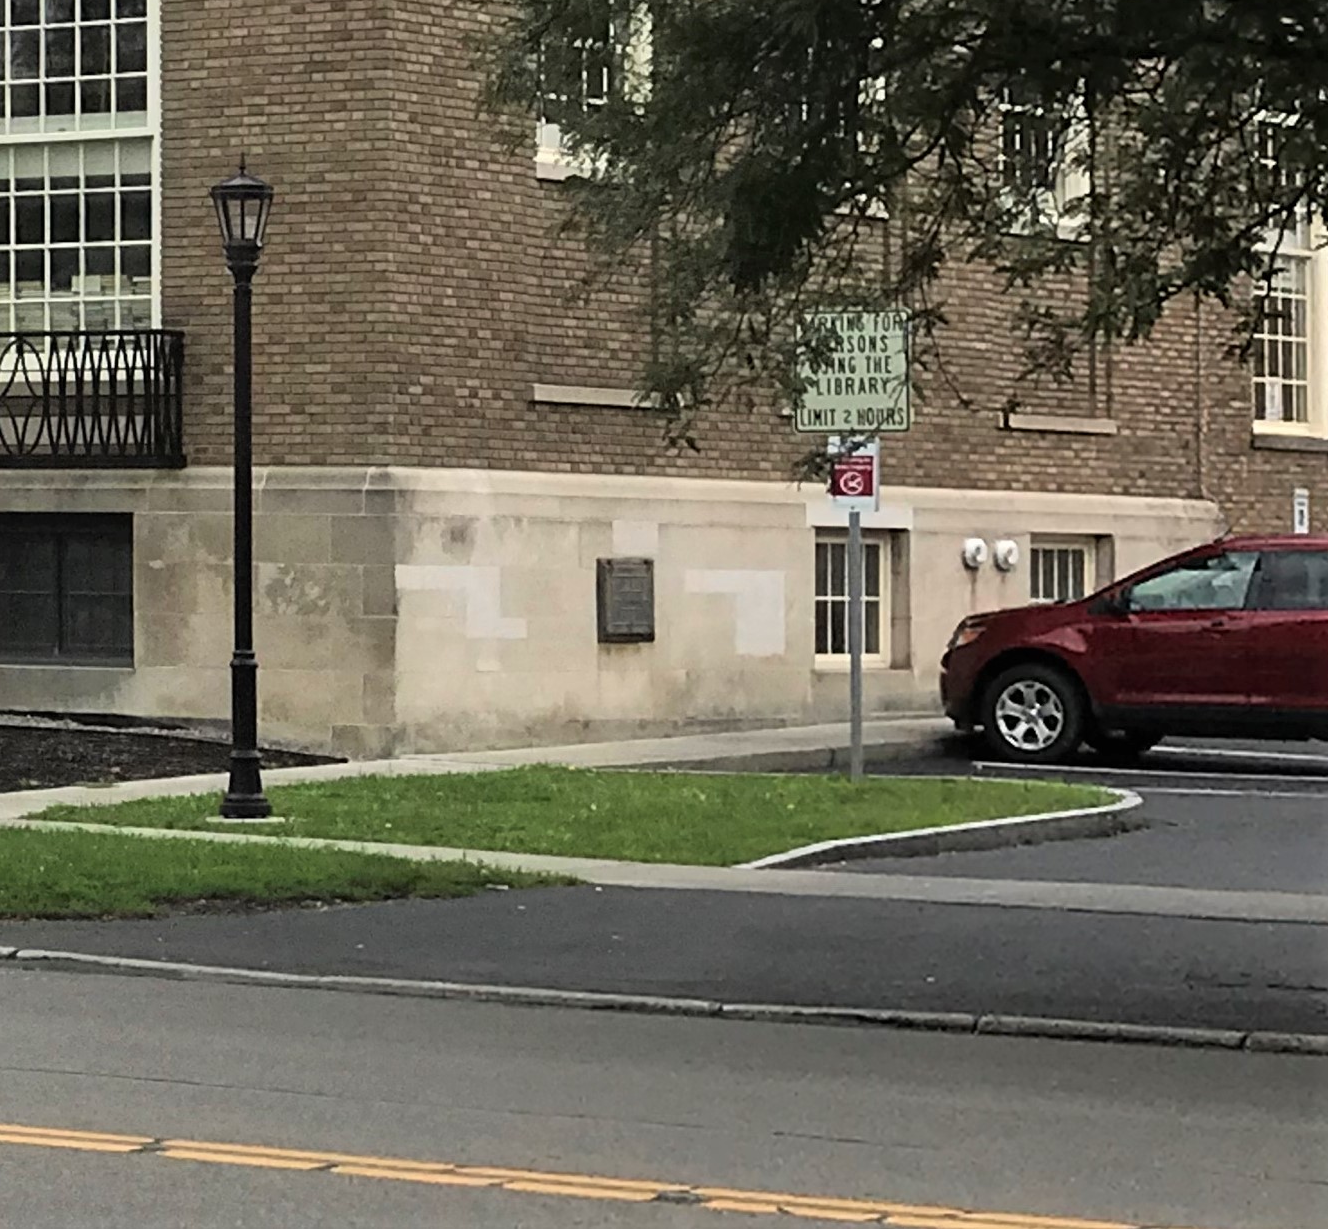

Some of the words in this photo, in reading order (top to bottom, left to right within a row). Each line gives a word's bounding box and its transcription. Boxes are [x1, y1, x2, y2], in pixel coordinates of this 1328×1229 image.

[873, 312, 905, 332] FOR
[865, 355, 892, 374] THE
[815, 376, 889, 396] LIBRARY
[800, 408, 837, 427] LIMIT
[843, 409, 853, 424] 2
[857, 407, 905, 426] HOURS
